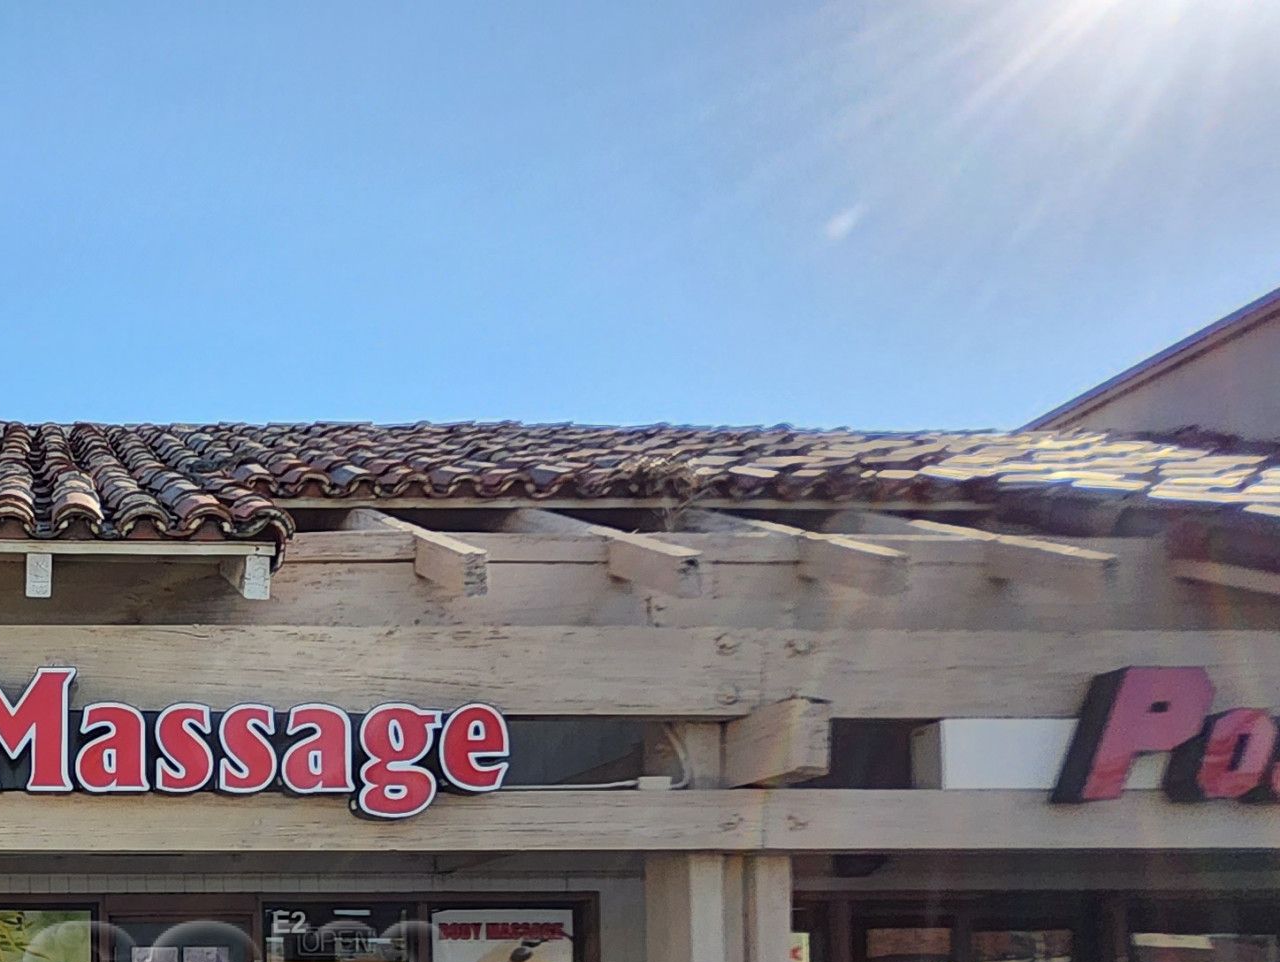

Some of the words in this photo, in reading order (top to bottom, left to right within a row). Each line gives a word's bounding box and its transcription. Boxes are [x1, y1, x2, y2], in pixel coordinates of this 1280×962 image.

[1070, 666, 1280, 803] Po
[273, 910, 307, 934] E2
[438, 922, 482, 940] BODY
[485, 922, 564, 940] MASSAGE
[302, 930, 371, 953] OPEN
